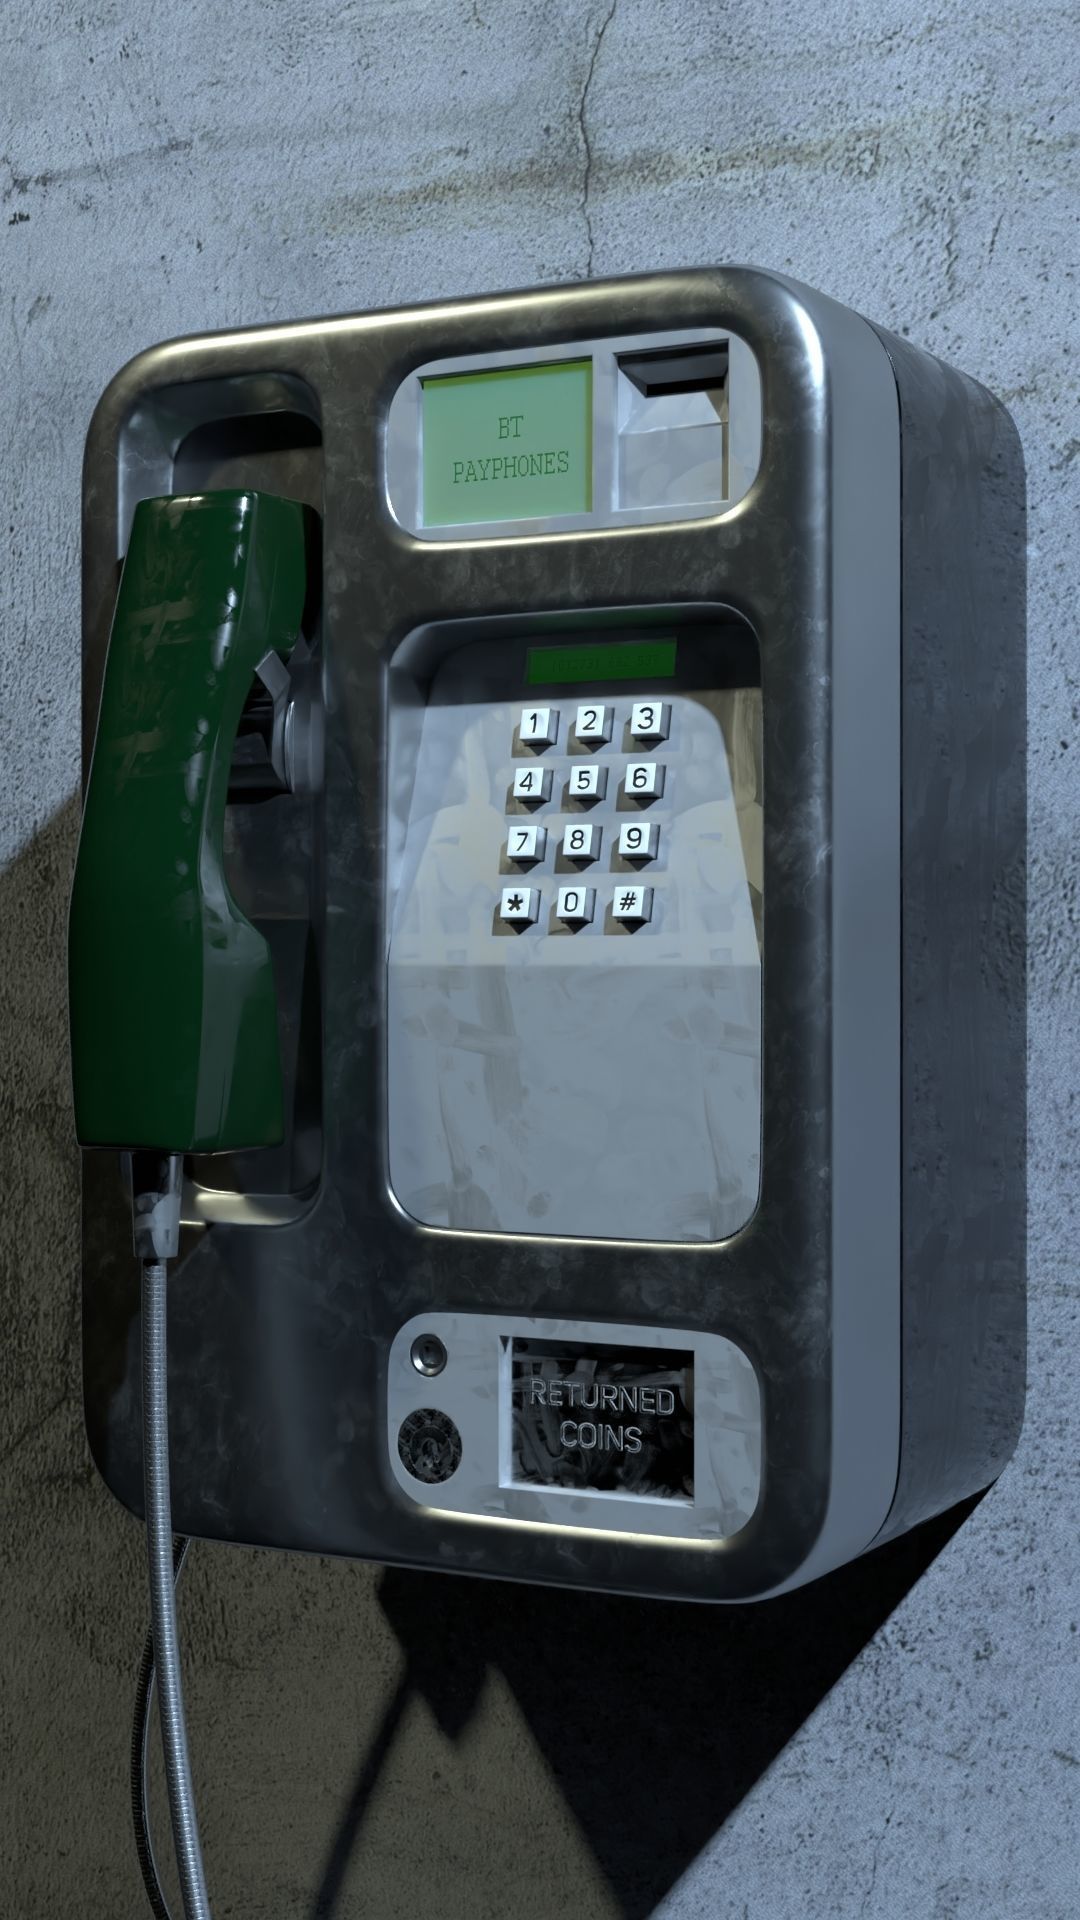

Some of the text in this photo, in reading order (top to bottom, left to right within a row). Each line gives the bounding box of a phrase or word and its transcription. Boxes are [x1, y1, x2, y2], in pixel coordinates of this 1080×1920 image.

[498, 415, 524, 439] BT
[453, 450, 569, 484] PAYPHONES
[529, 713, 538, 734] 1
[582, 710, 597, 731] 2
[637, 707, 654, 730] 3
[519, 771, 533, 792] 4
[577, 771, 591, 790] 5
[632, 767, 648, 788] 6
[516, 832, 529, 851] 7
[570, 829, 585, 850] 8
[626, 827, 642, 849] 9
[620, 892, 637, 911] #
[529, 1378, 676, 1416] RETURNED
[559, 1420, 643, 1454] COINS
